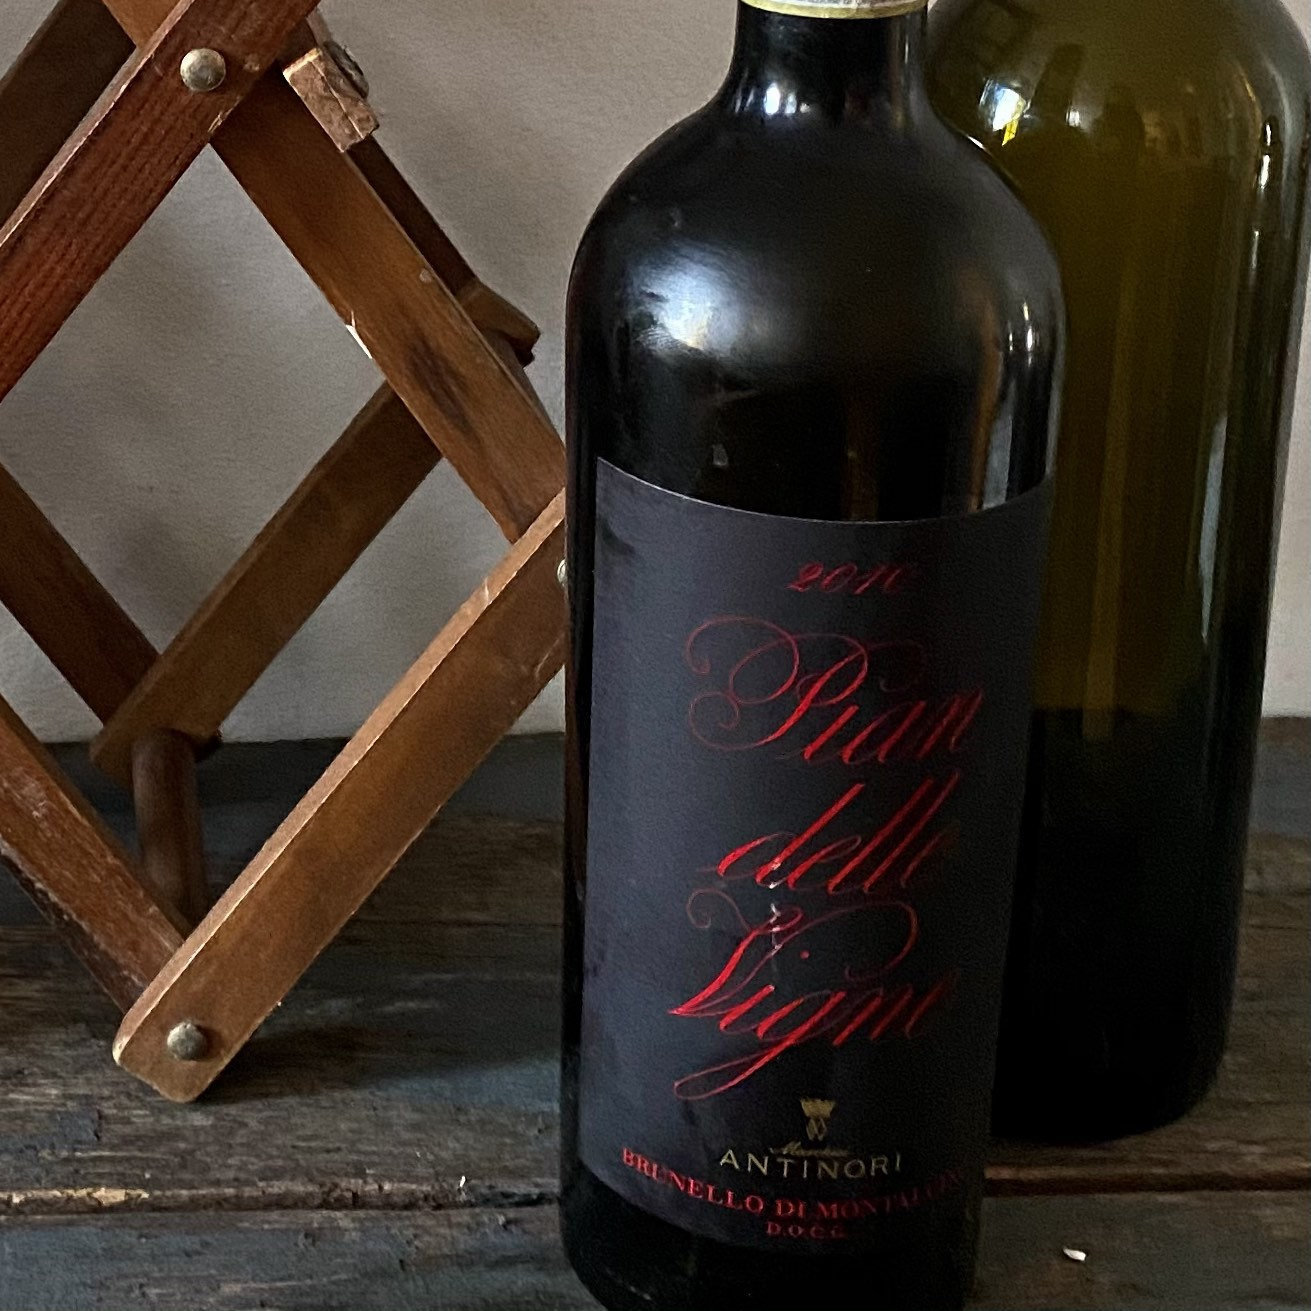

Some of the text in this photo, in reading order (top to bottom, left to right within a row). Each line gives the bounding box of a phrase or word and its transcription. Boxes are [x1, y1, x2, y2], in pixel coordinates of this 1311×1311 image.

[622, 1146, 765, 1215] BRUNELLO
[775, 1198, 807, 1219] DI
[719, 1148, 902, 1181] ANTINORI
